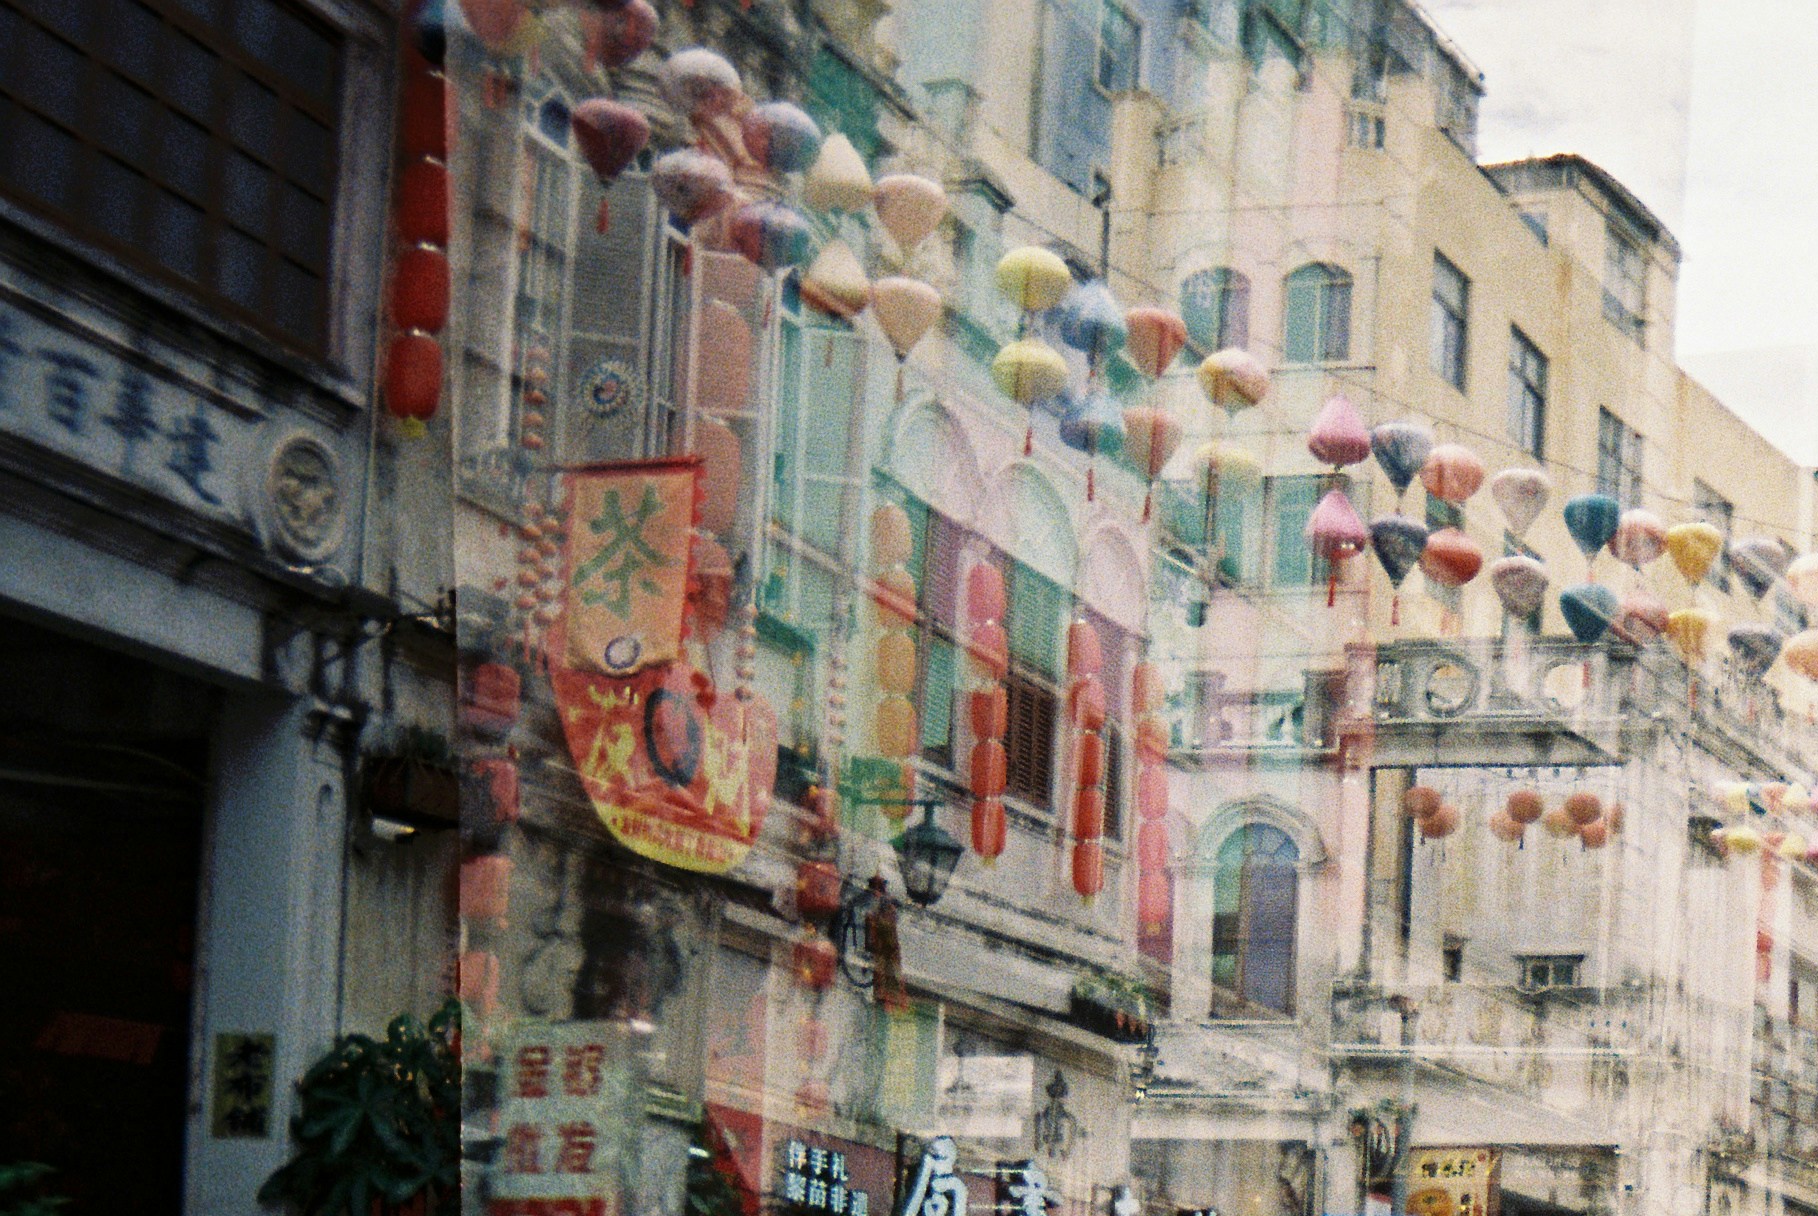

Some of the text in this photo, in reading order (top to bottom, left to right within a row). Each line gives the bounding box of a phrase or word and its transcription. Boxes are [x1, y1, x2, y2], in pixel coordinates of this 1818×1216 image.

[572, 483, 682, 622] 茶
[788, 1139, 849, 1181] 伴手礼
